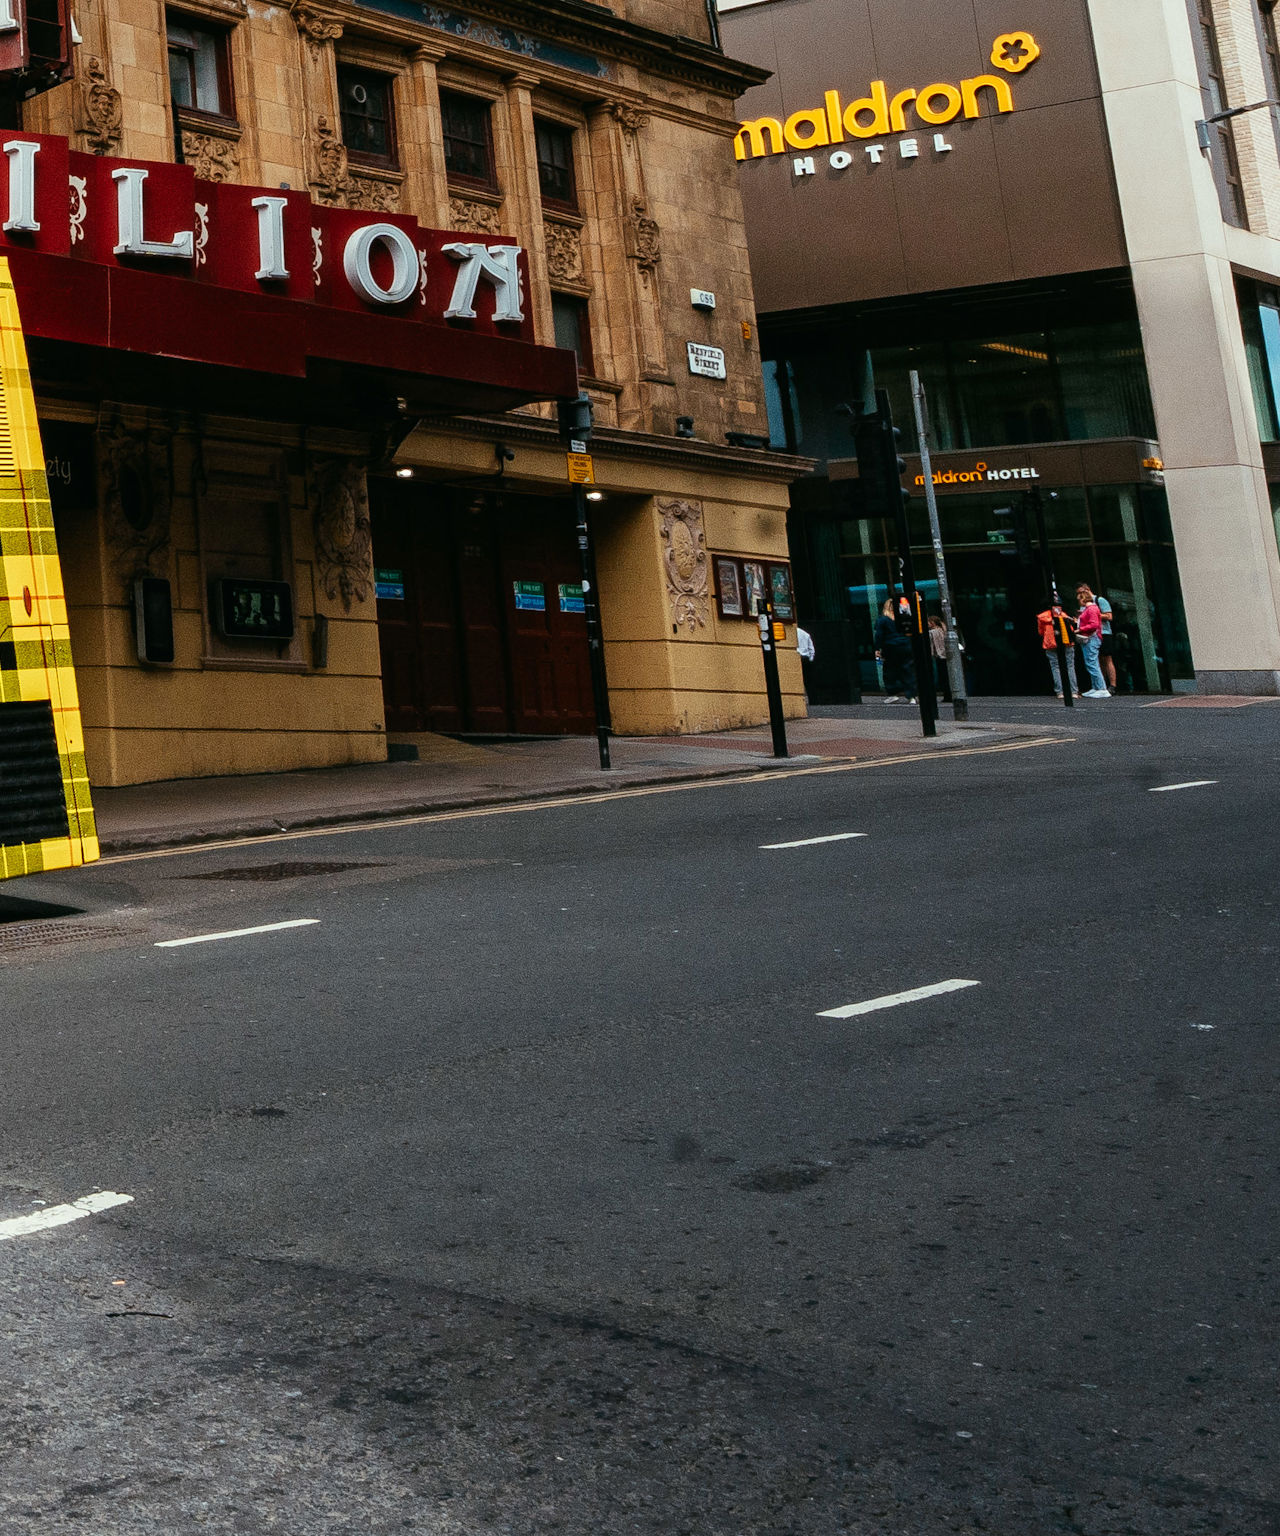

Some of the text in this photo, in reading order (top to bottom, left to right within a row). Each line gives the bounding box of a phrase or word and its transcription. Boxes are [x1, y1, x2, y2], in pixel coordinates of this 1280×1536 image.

[733, 74, 1014, 161] maldron
[793, 133, 953, 176] HOTEL
[987, 467, 1040, 481] HOTEL
